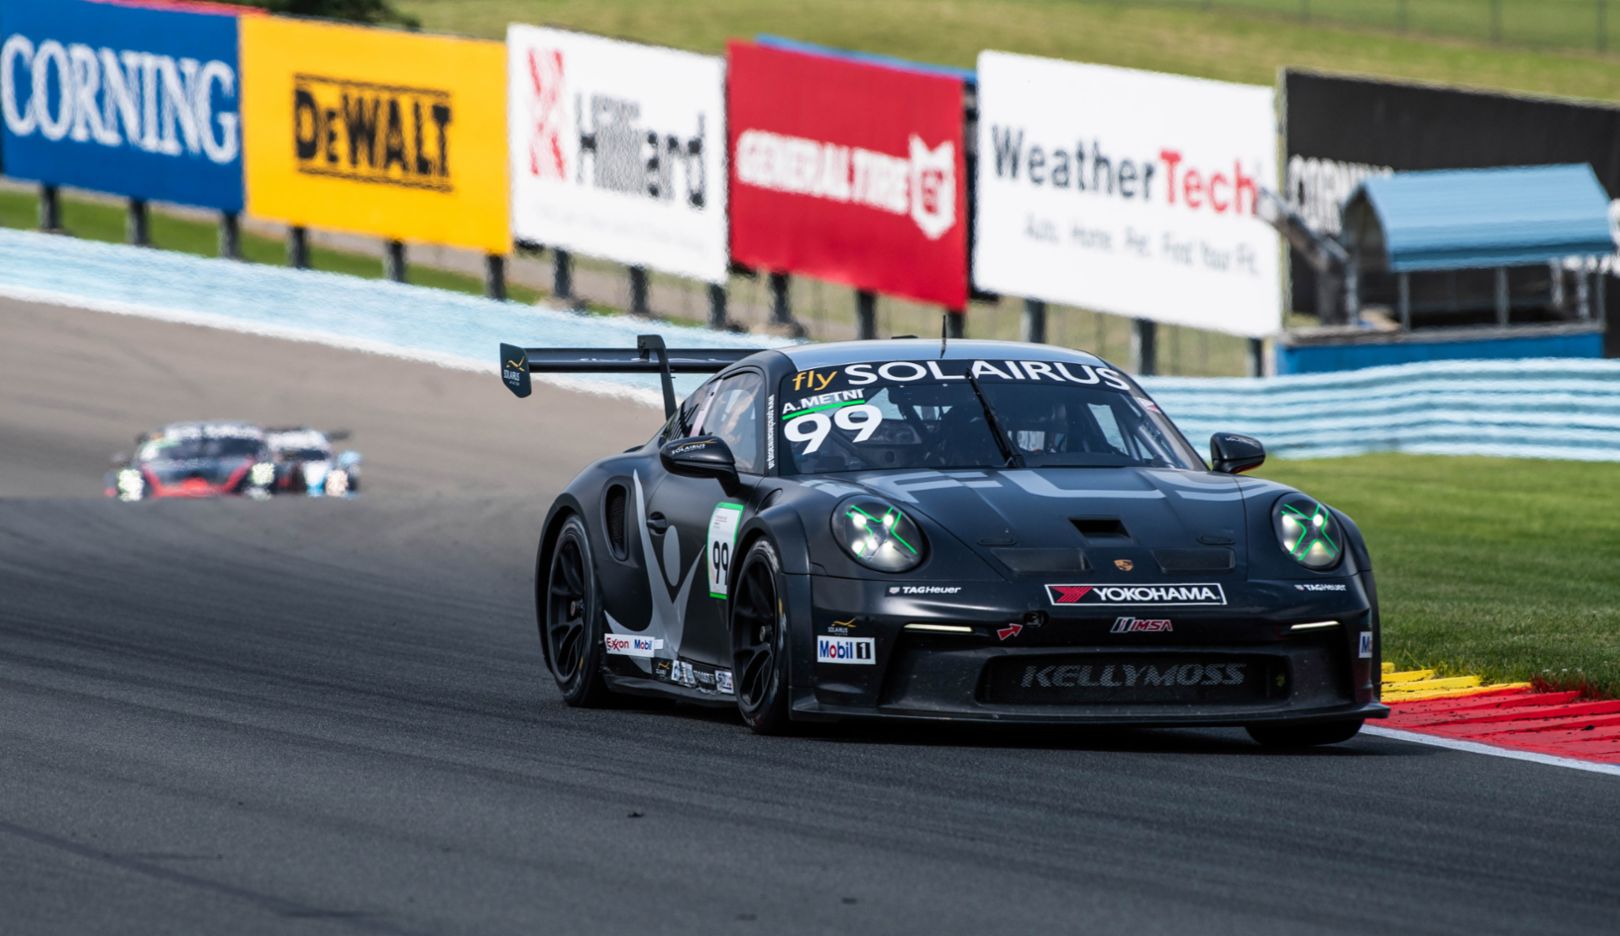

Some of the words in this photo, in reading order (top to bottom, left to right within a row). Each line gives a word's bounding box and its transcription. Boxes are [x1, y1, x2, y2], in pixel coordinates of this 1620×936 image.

[0, 33, 240, 164] CORNING
[735, 128, 851, 204] GENERAL
[852, 147, 911, 216] TIRE
[991, 124, 1259, 217] WeatherTech
[792, 370, 838, 391] fly
[844, 360, 1131, 391] SOLAIRUS
[782, 388, 865, 415] A.METNI
[783, 404, 883, 456] 99
[712, 540, 729, 586] 99
[1093, 587, 1217, 601] YOKOHAMA
[1128, 619, 1174, 632] IMSA
[606, 637, 630, 651] Exxon
[634, 639, 653, 650] Mobil
[819, 640, 853, 659] Mobil
[858, 642, 869, 659] 1
[1020, 662, 1249, 688] KELLYMOSS
